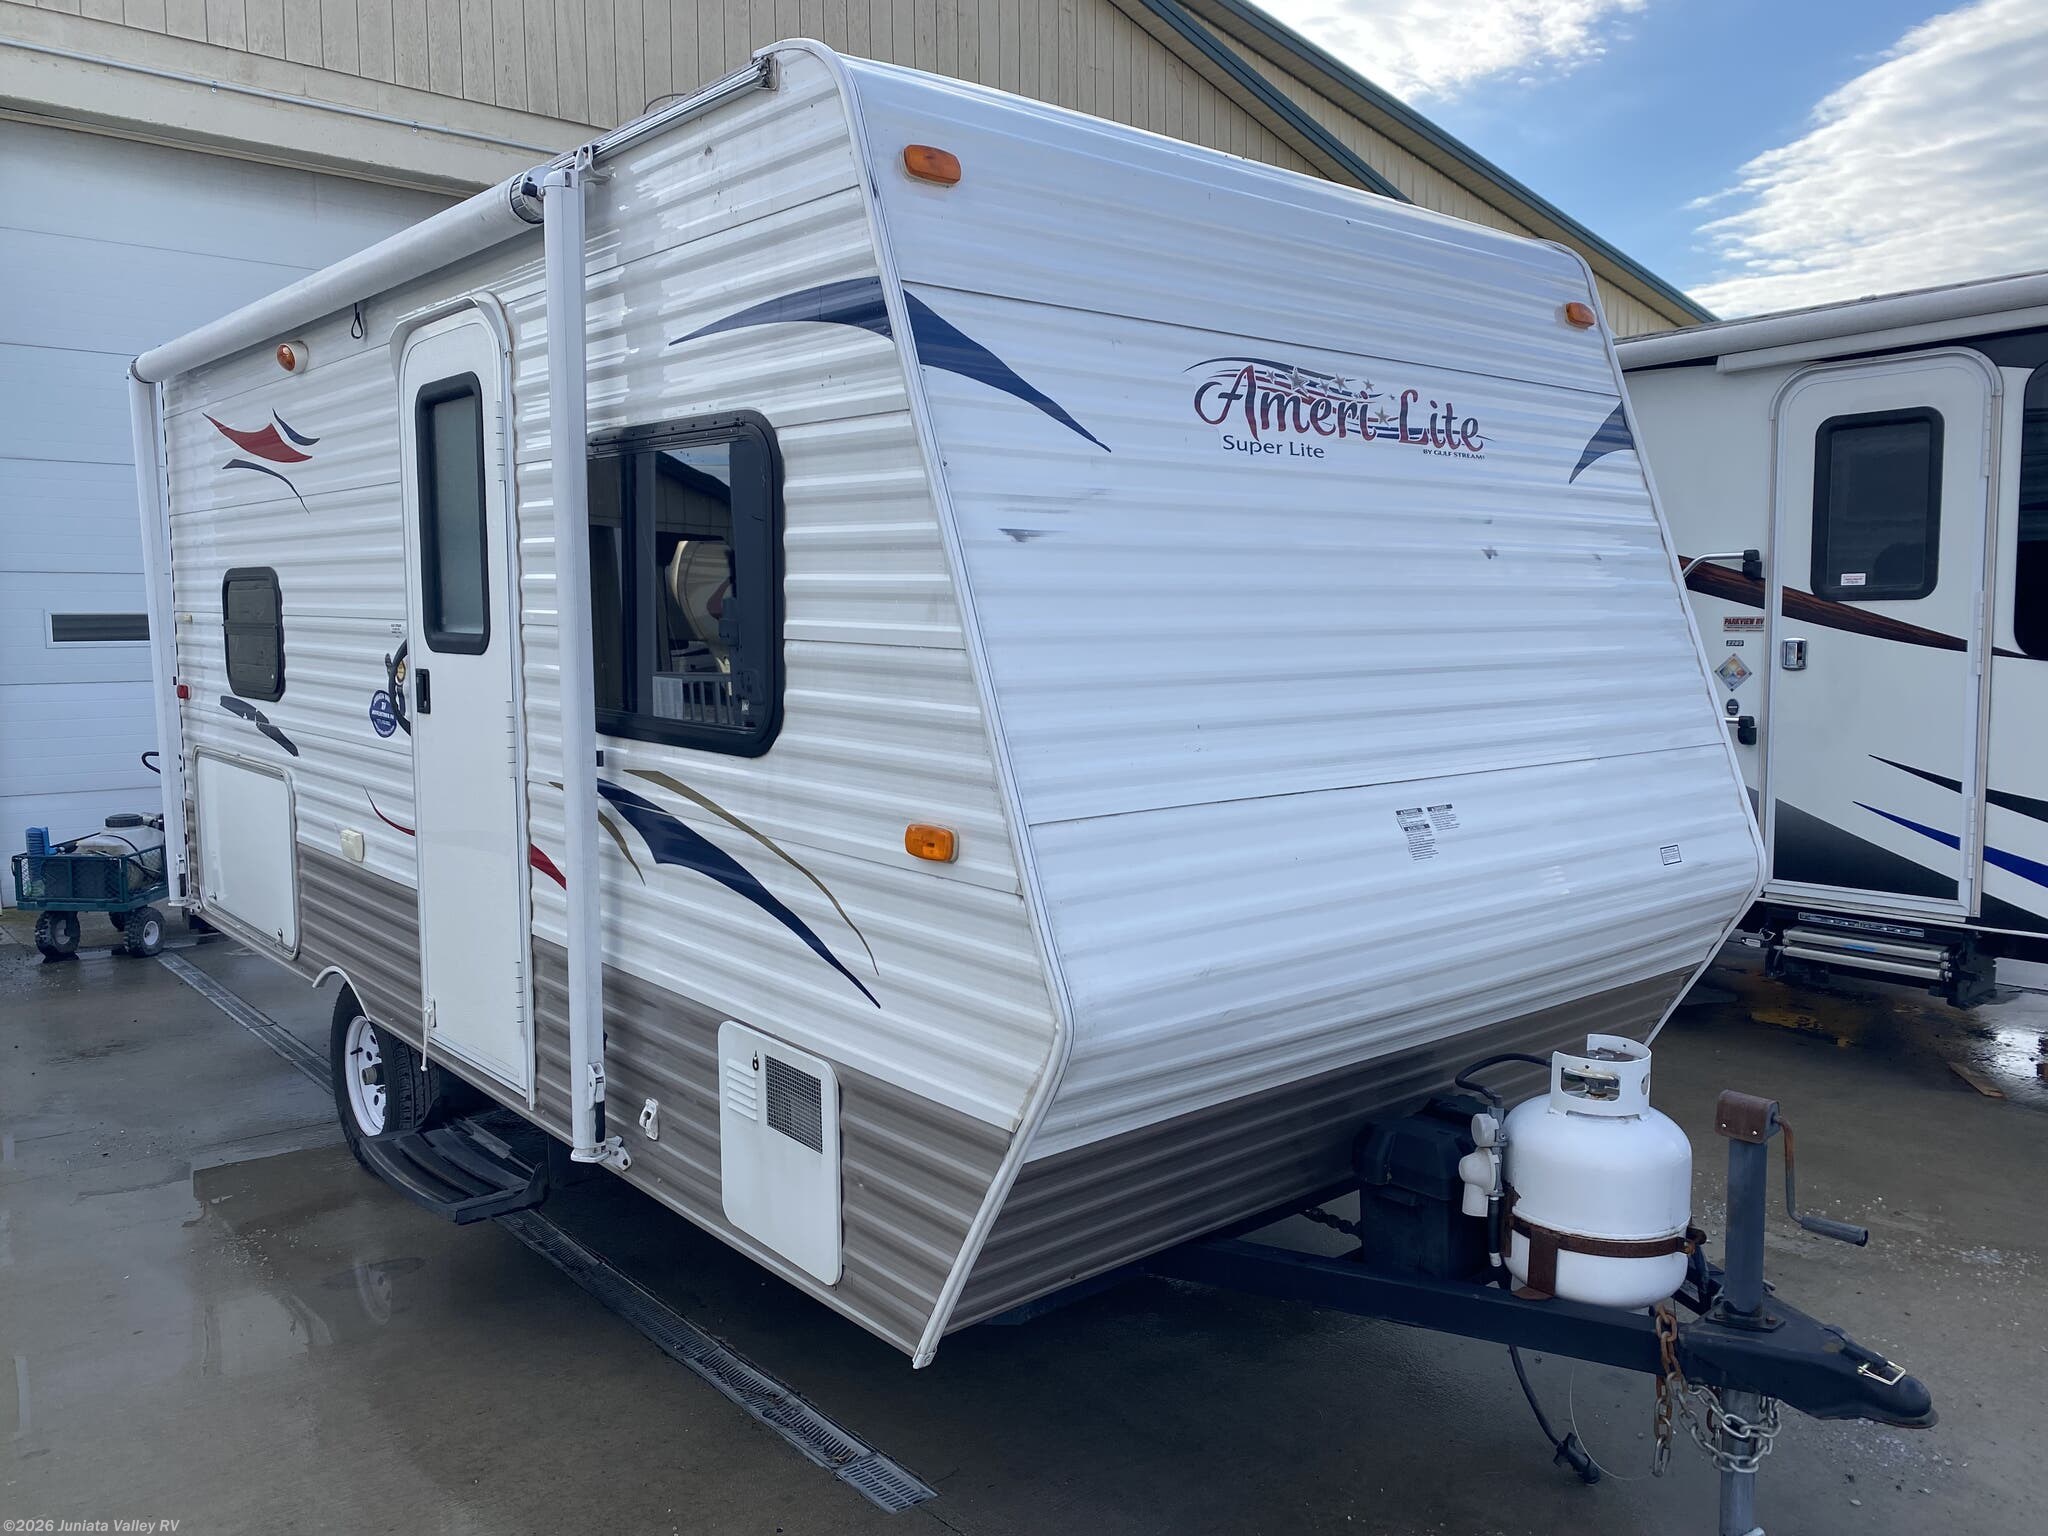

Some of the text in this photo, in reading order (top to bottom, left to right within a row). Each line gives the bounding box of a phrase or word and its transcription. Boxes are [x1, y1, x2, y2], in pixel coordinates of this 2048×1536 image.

[1194, 364, 1483, 452] Ameri Lite
[1222, 435, 1325, 459] Super Lite
